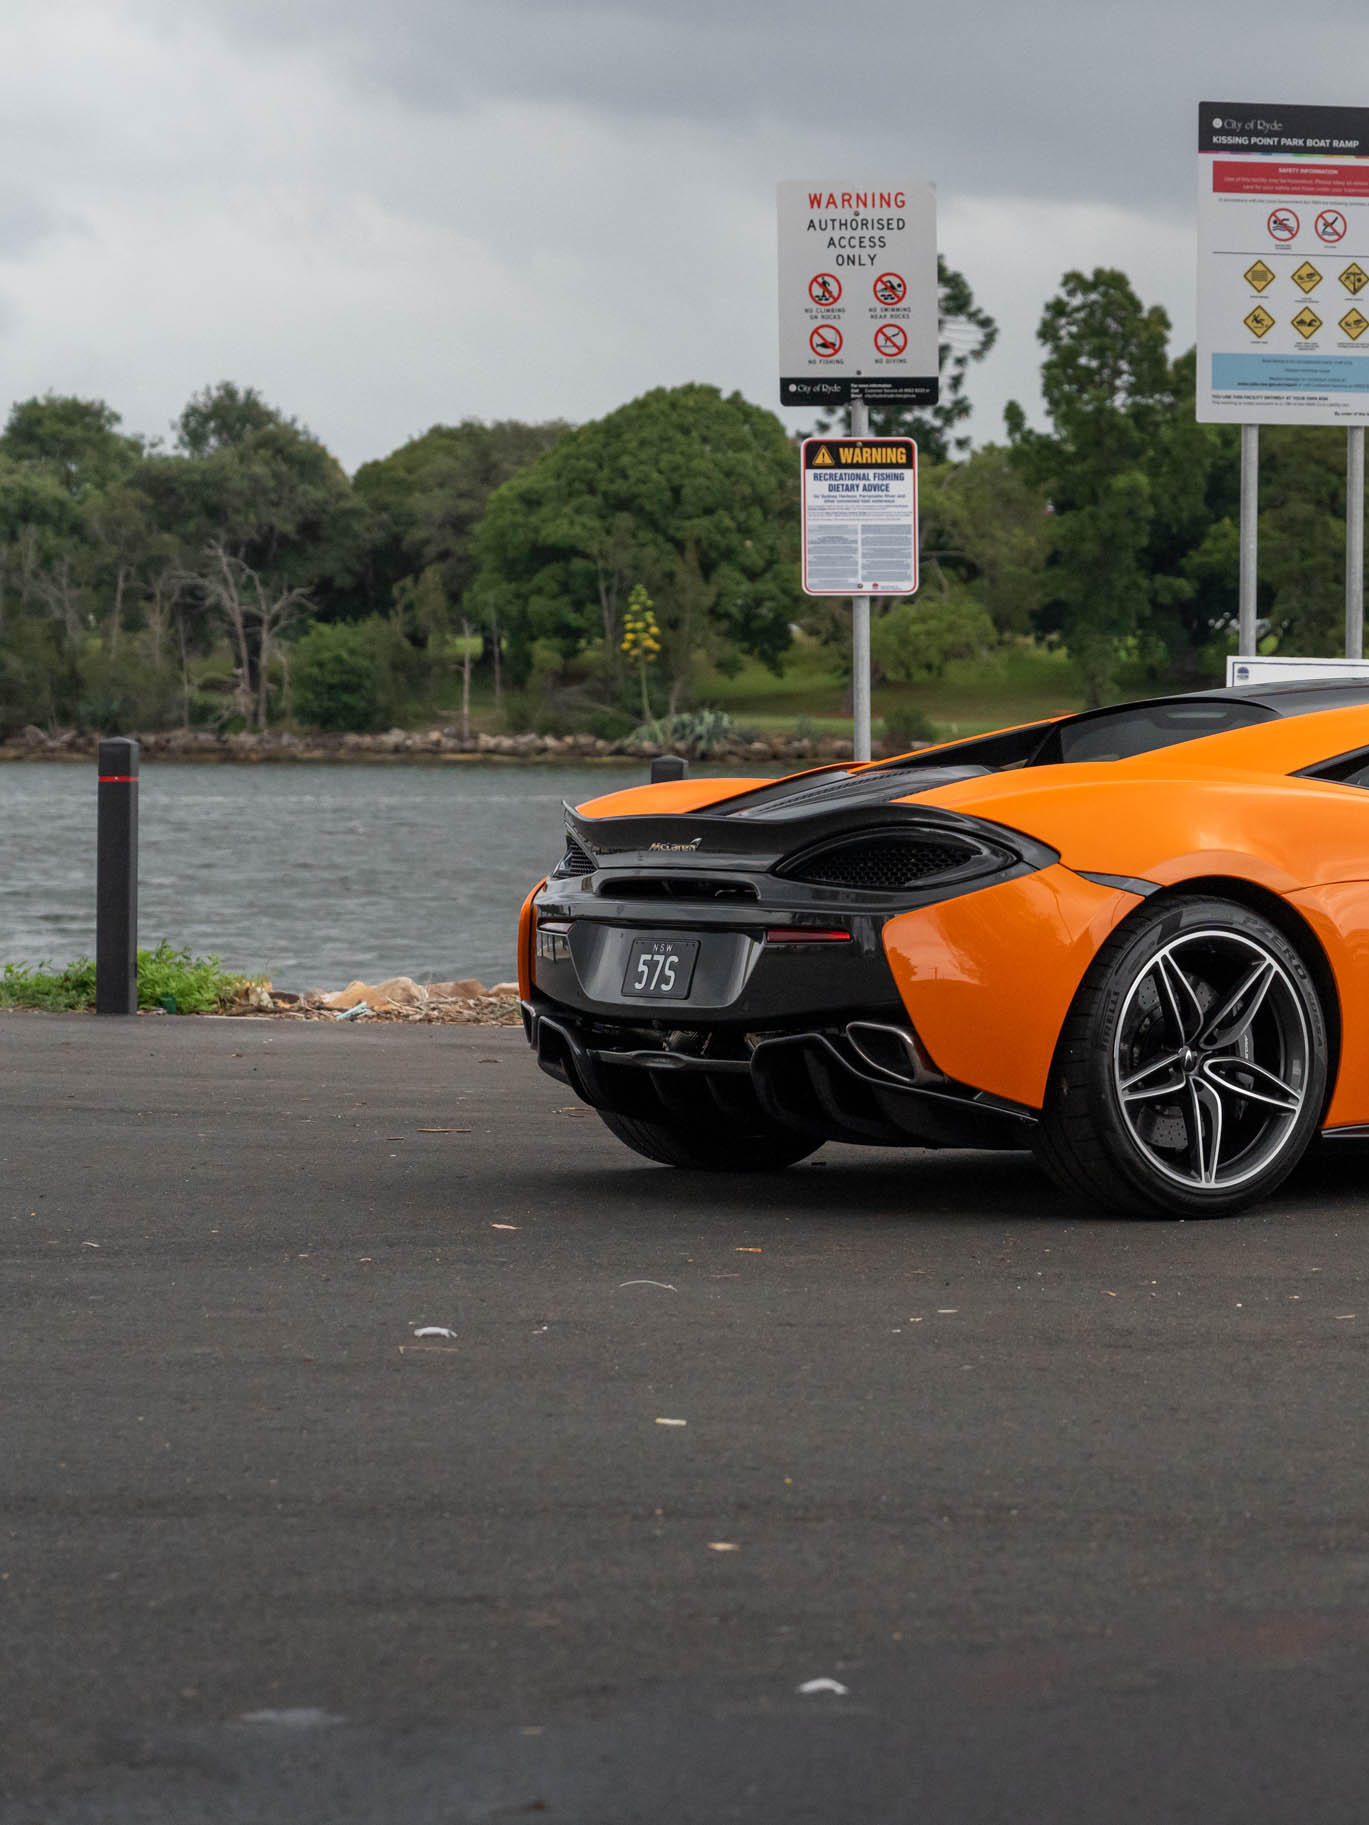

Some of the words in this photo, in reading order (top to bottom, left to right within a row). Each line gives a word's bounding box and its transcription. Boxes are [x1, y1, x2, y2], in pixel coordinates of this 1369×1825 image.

[1224, 118, 1242, 132] City
[1244, 120, 1256, 130] of
[1257, 120, 1283, 133] Ryde
[1212, 136, 1249, 145] KISSING
[1250, 136, 1279, 146] POINT
[1280, 137, 1304, 146] PARK
[1306, 138, 1331, 148] BOAT
[1332, 140, 1359, 148] RAMP
[808, 192, 906, 209] WARNING
[807, 218, 906, 232] AUTHORISED
[827, 236, 886, 248] ACCESS
[836, 254, 877, 266] ONLY
[797, 384, 811, 394] City
[813, 384, 821, 392] of
[822, 384, 841, 394] Ryde
[839, 448, 907, 464] WARNING
[813, 472, 871, 482] RECREATIONAL
[873, 472, 905, 482] FISHING
[828, 483, 860, 492] DIETARY
[862, 483, 890, 492] ADVICE
[652, 944, 673, 952] NSW
[634, 954, 679, 991] 57S
